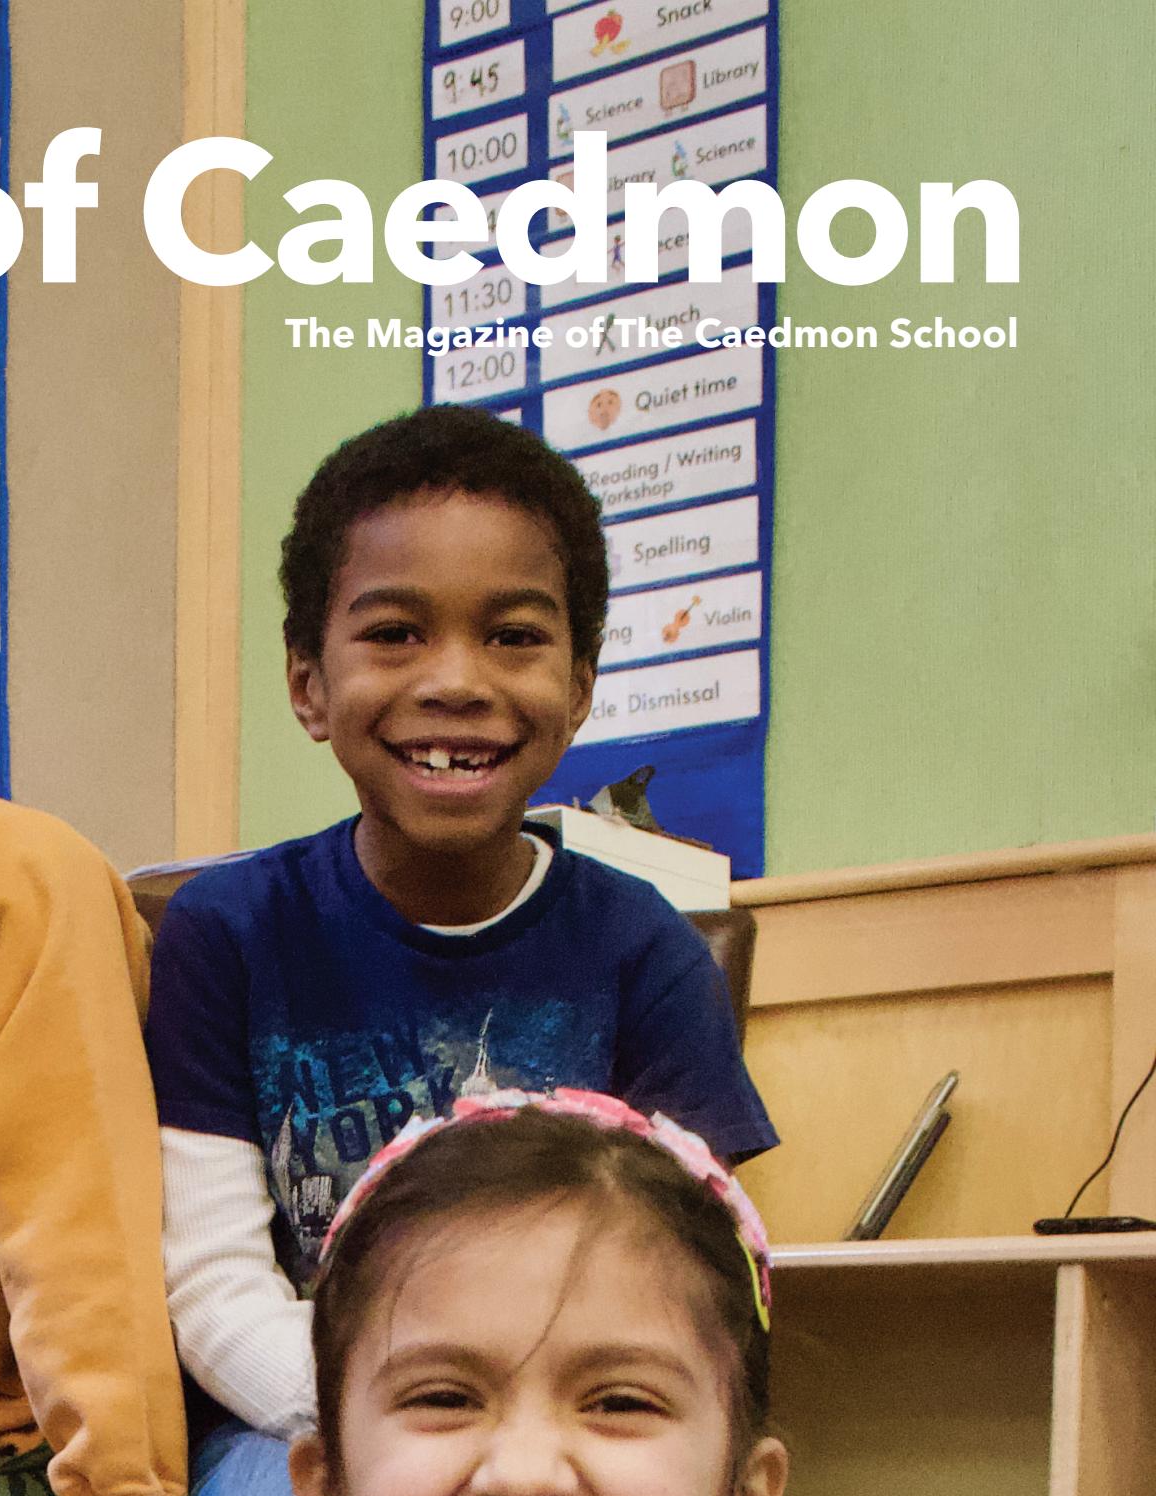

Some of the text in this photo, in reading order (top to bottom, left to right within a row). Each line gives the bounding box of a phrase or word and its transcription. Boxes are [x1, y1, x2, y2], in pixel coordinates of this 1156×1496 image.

[451, 0, 499, 29] 9:00
[657, 0, 713, 27] Snack
[586, 61, 759, 124] Science Library
[448, 132, 516, 172] 10:00
[696, 137, 756, 164] Science
[444, 278, 512, 317] 11:30
[446, 351, 515, 391] 12:00
[636, 375, 737, 412] Quiet time
[588, 463, 659, 488] Reading
[677, 444, 742, 468] Writing
[634, 535, 711, 566] Spelling
[704, 606, 752, 627] Violin
[628, 680, 720, 713] Dismissal
